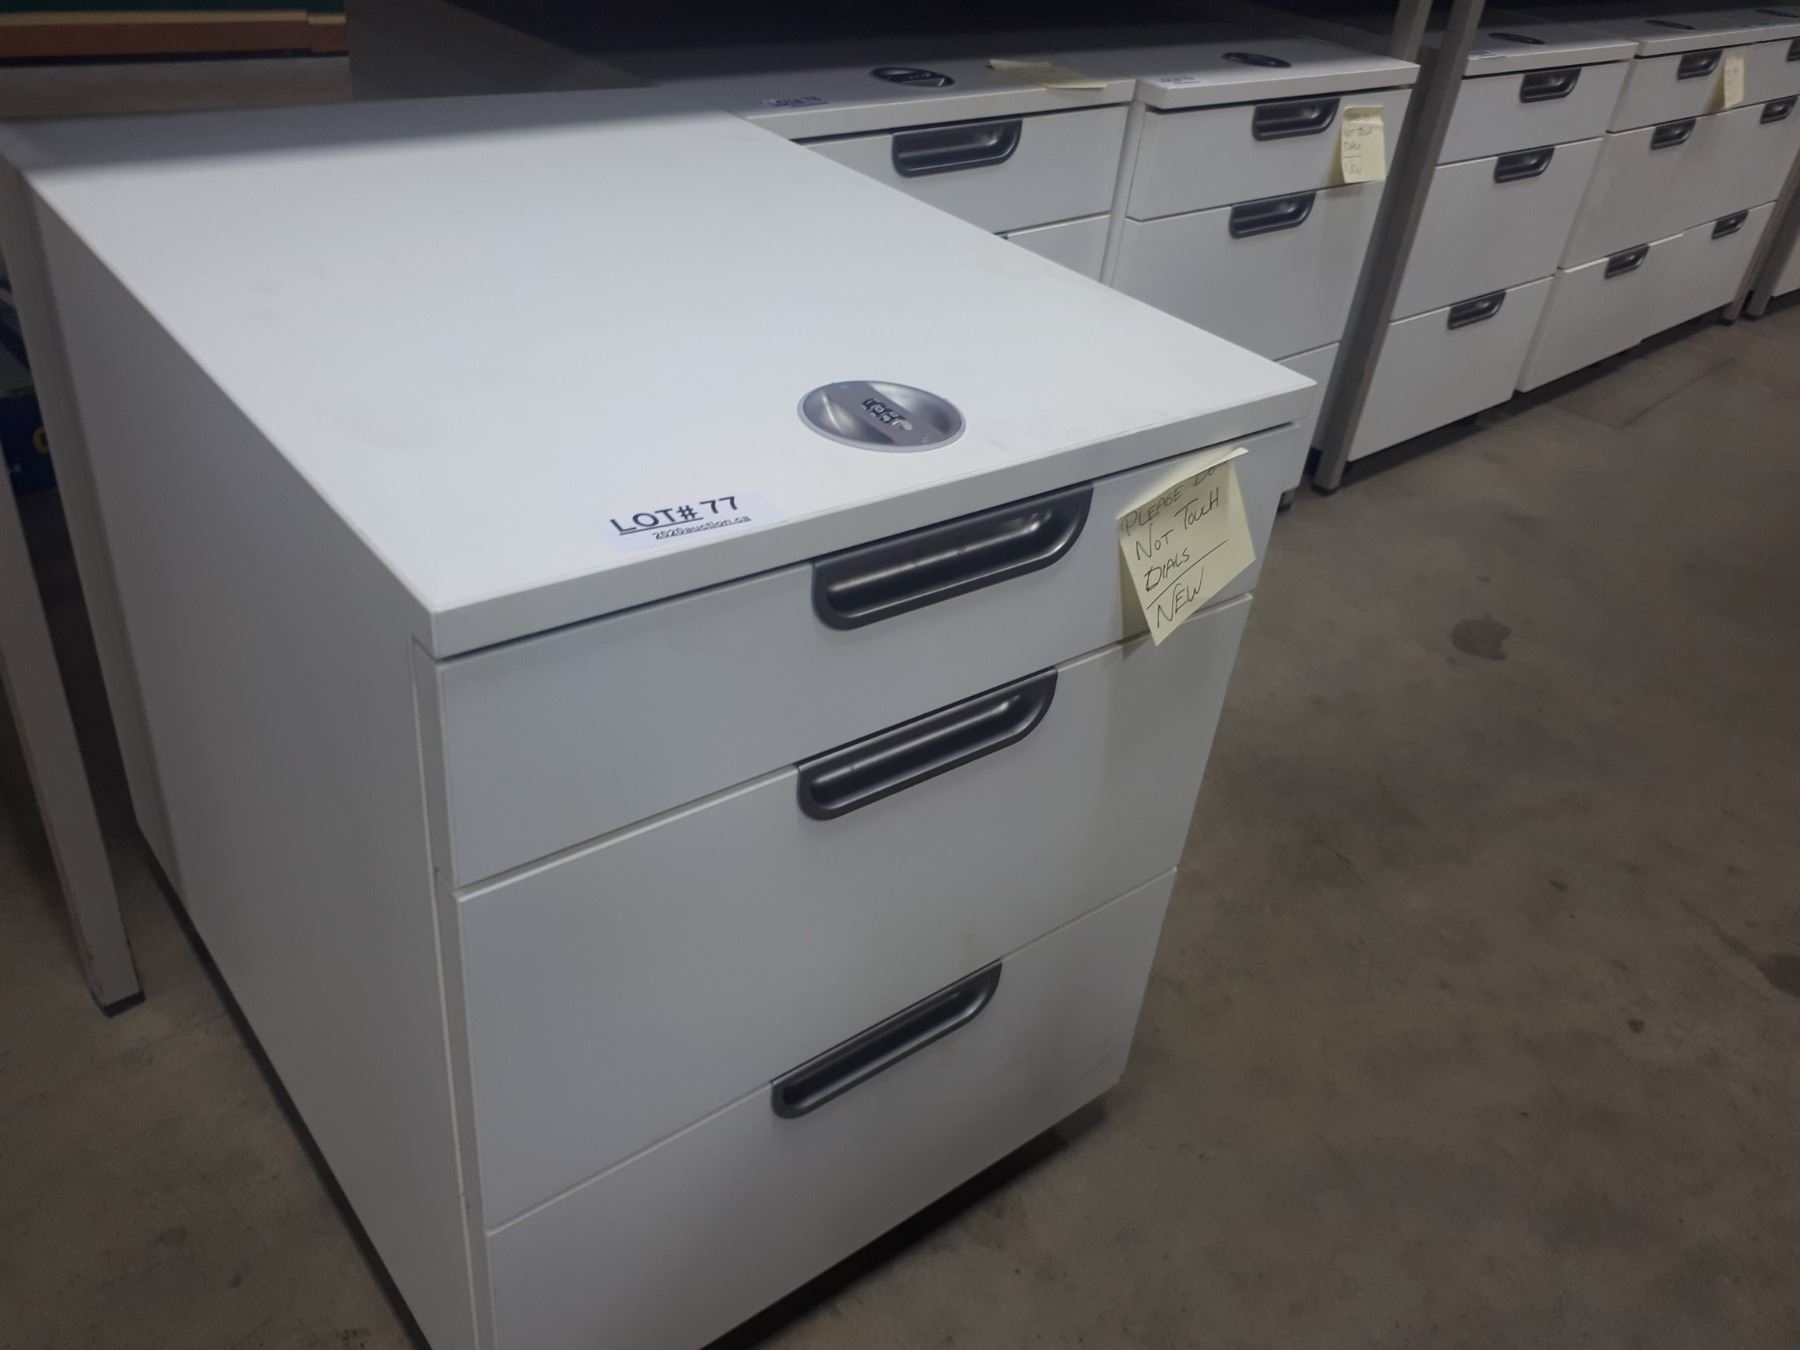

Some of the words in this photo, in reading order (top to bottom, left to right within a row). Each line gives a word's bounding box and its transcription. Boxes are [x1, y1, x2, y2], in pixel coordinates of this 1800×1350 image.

[610, 504, 699, 535] LOT#
[701, 496, 739, 514] 77
[1121, 487, 1184, 537] PLEASE
[1136, 522, 1174, 561] NOT
[1144, 547, 1190, 593] DIALS
[1156, 566, 1206, 628] NEW
